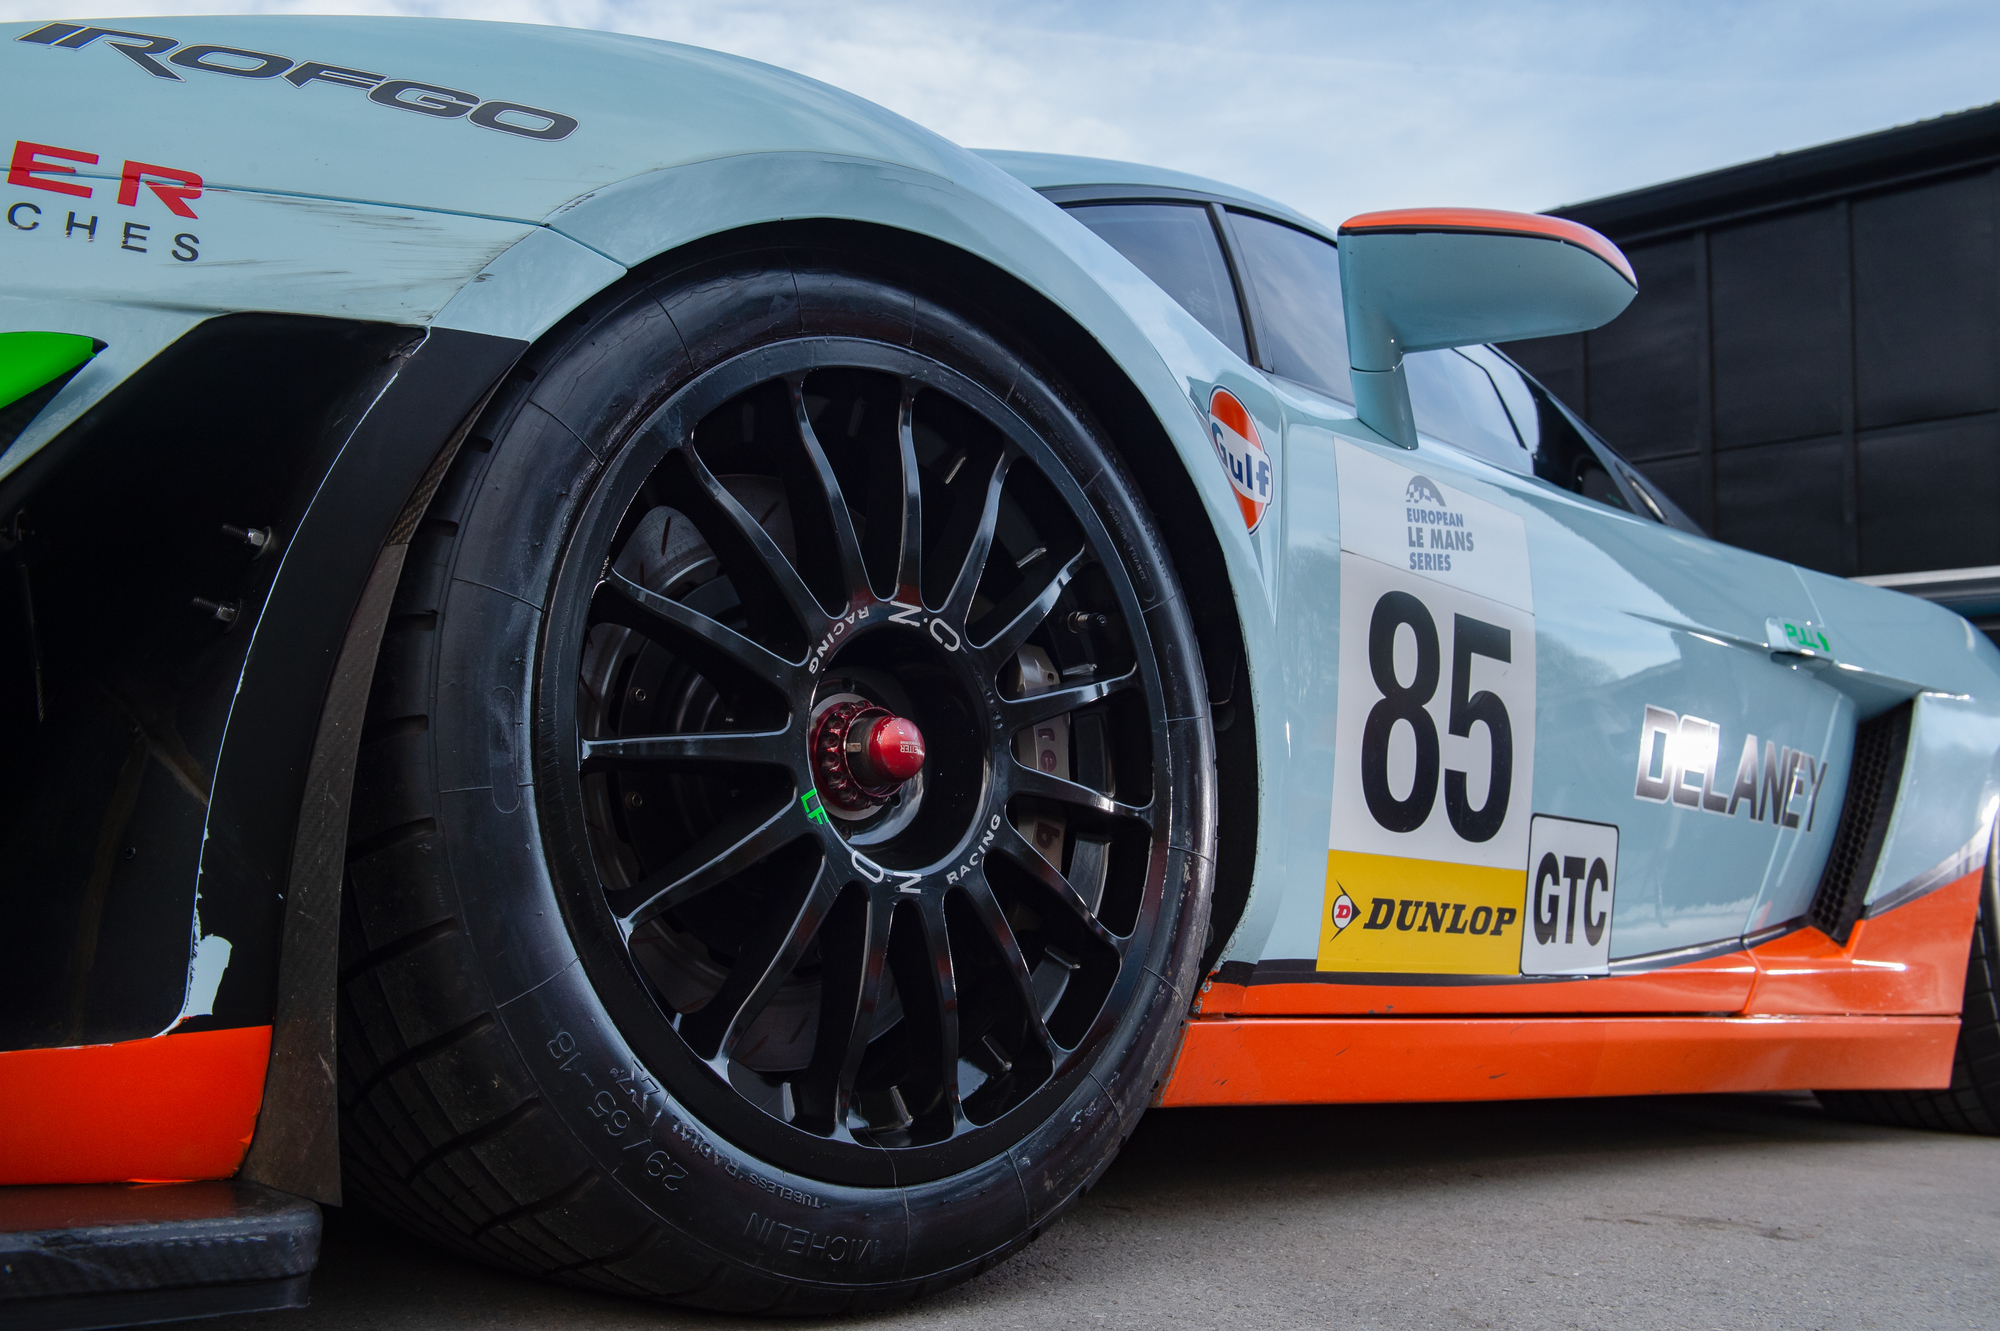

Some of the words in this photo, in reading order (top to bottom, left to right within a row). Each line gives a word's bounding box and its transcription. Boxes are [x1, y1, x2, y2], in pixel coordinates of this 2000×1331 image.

[1211, 421, 1270, 498] Gulf
[1406, 508, 1464, 528] EUROPEAN
[1408, 526, 1425, 549] LE
[1430, 528, 1475, 552] MANS
[1409, 552, 1452, 572] SERIES
[808, 606, 870, 675] RACING
[1361, 590, 1513, 843] 85
[1634, 704, 1829, 833] DELANEY
[801, 788, 830, 825] LF
[945, 813, 1001, 885] RACING
[1362, 897, 1517, 936] DUNLOP
[1533, 852, 1609, 947] GTC
[750, 1172, 821, 1209] TUBELESS
[743, 1212, 881, 1264] MICHELIN
